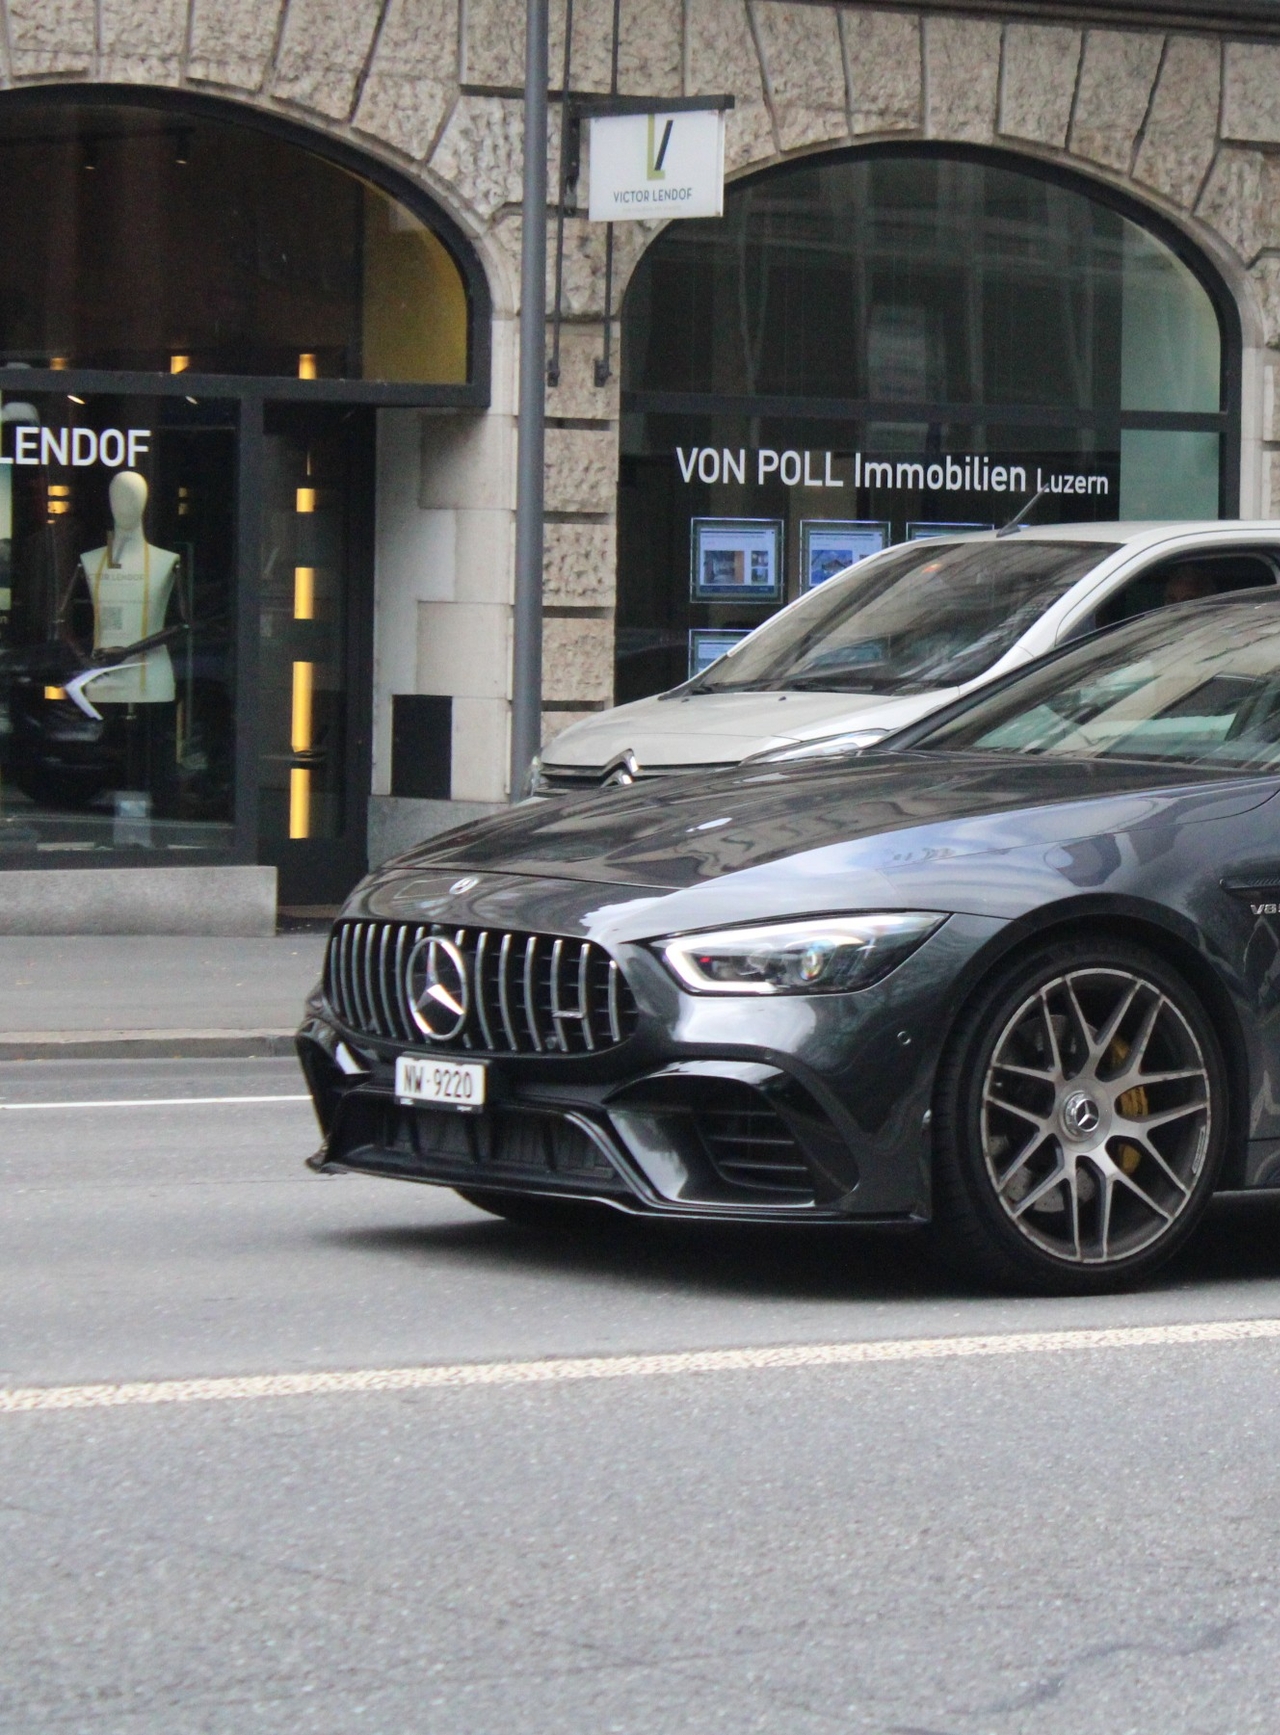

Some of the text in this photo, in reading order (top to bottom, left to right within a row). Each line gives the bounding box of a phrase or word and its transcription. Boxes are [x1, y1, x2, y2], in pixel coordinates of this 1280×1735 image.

[613, 188, 692, 203] VICTOR LENDOF
[676, 447, 1109, 495] VON POLL Immobilien Luzern
[1250, 903, 1277, 915] V8
